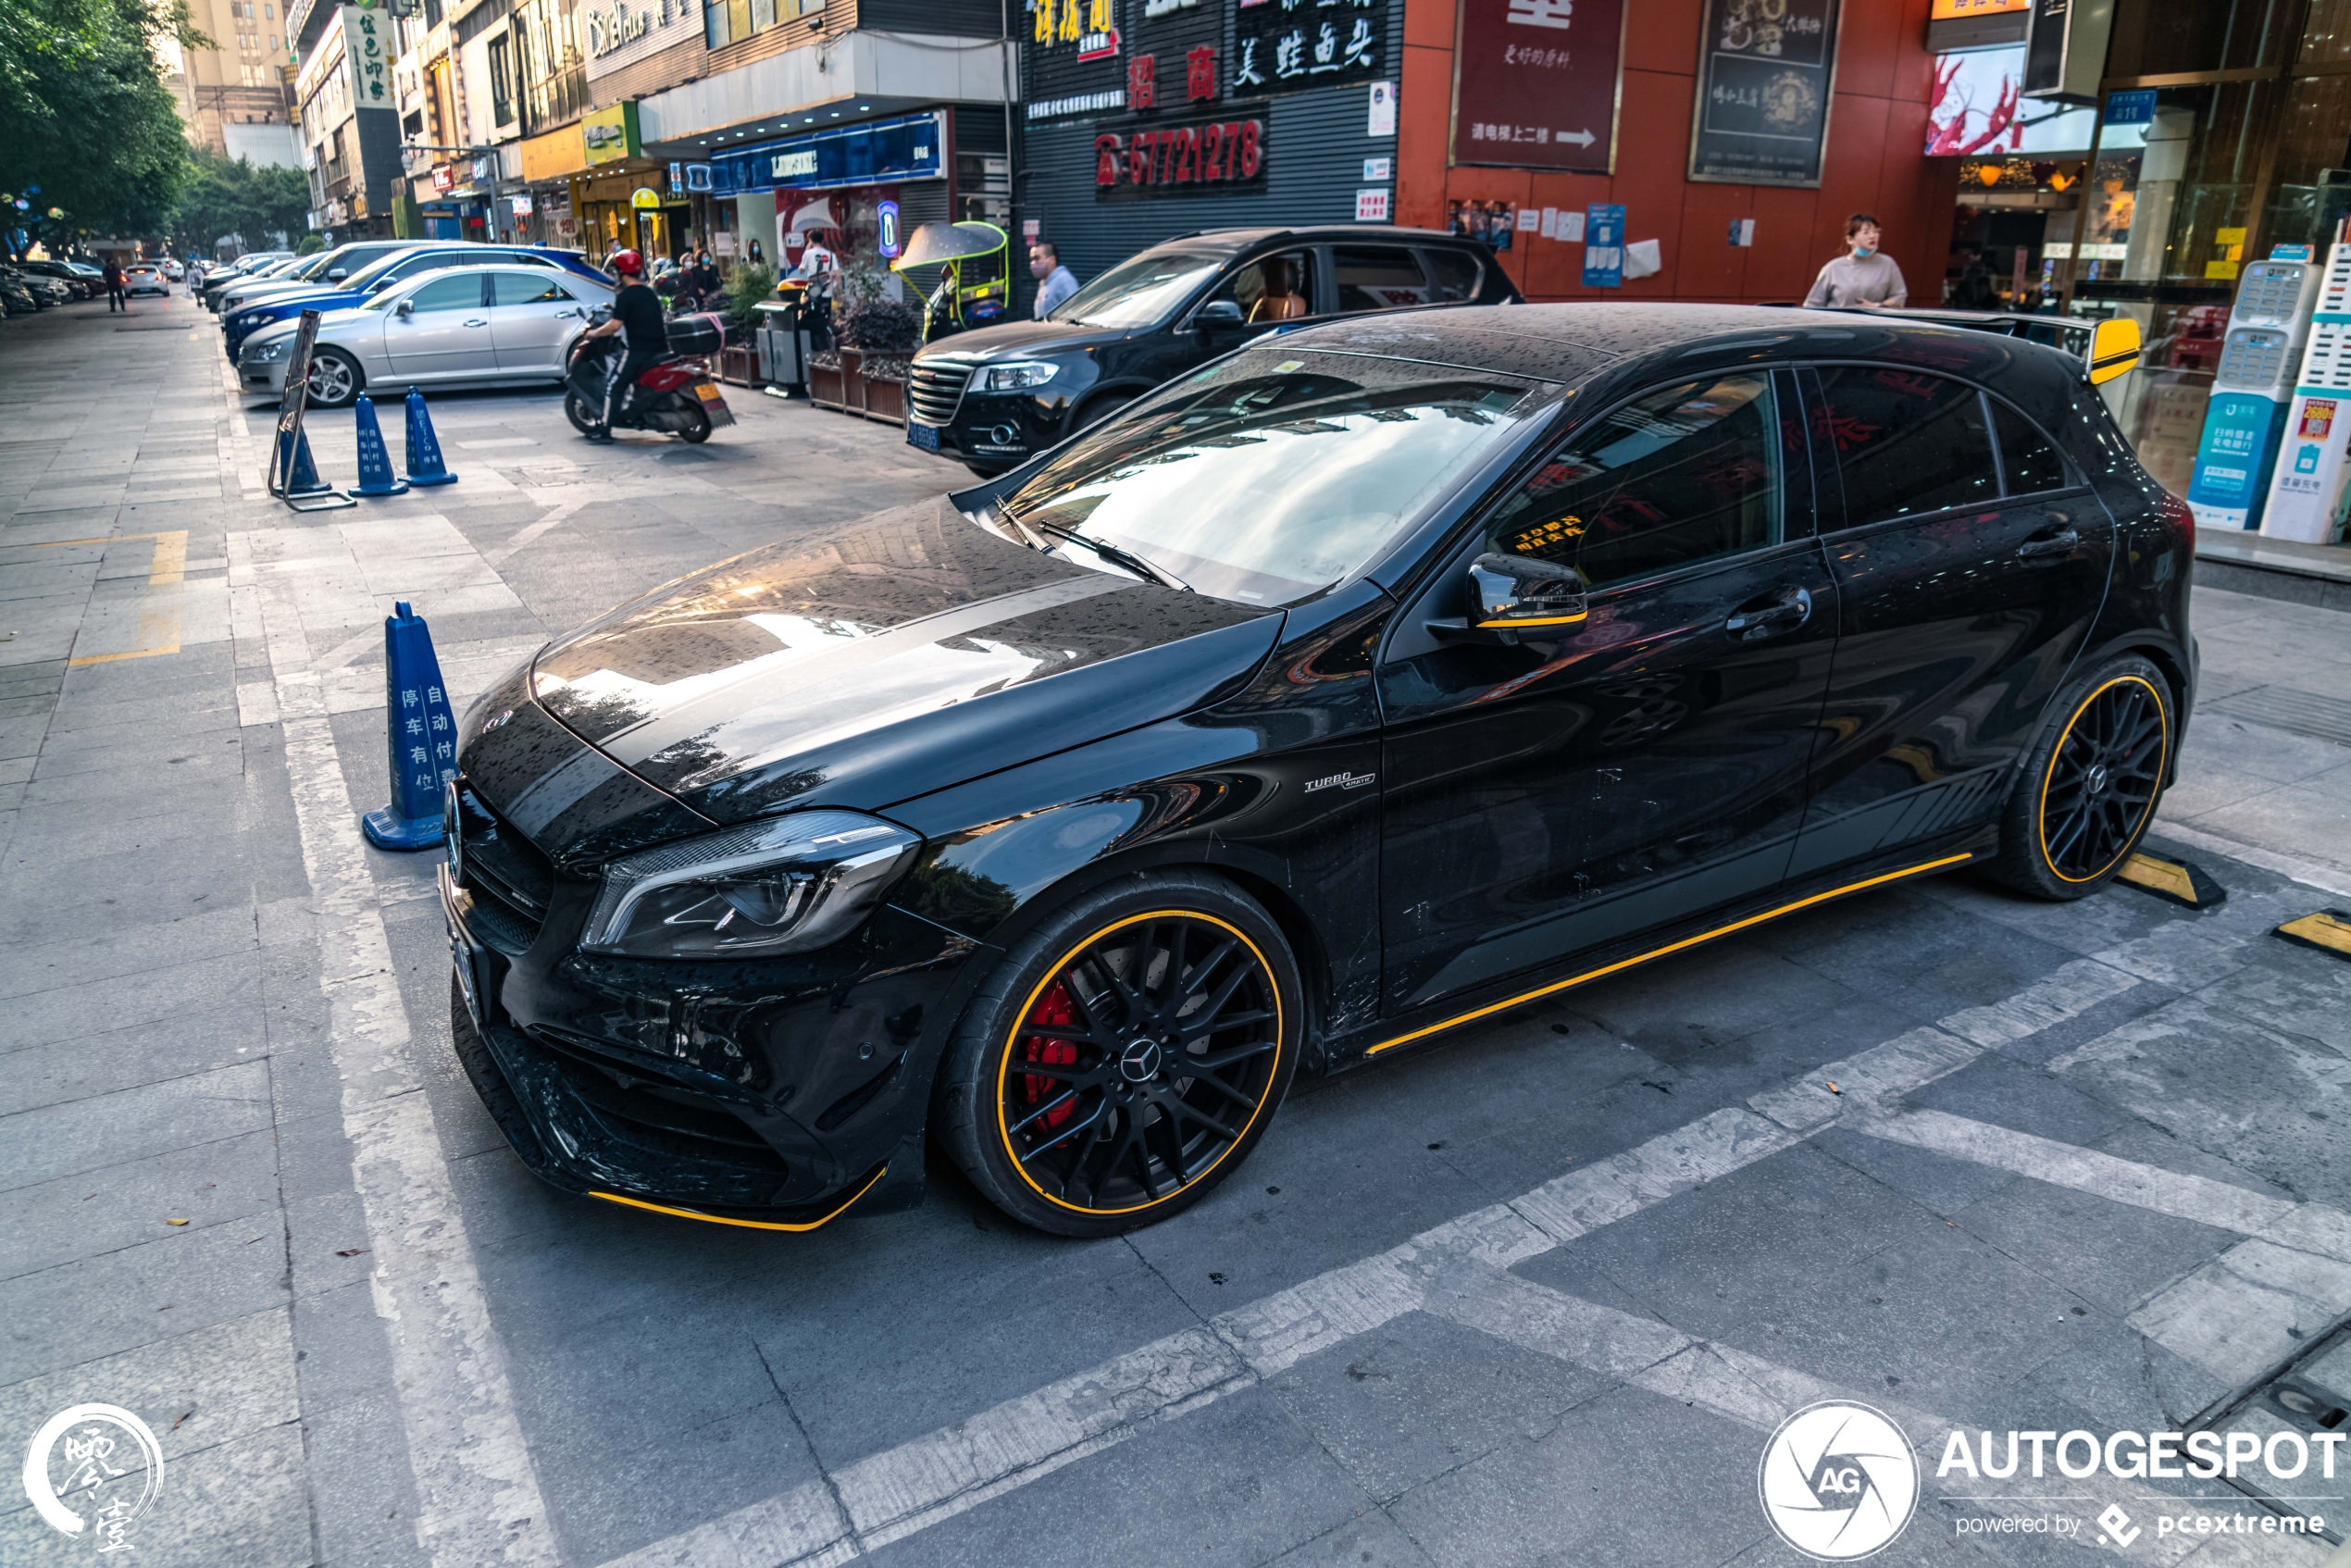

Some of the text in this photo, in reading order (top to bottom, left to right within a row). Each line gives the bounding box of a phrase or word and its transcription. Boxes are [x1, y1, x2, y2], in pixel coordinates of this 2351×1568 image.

[1127, 45, 1216, 110] 招商
[1233, 18, 1374, 86] 美蛙鱼头
[1473, 122, 1549, 144] 请电梯上二楼
[402, 689, 434, 791] 停车有位
[428, 686, 458, 788] 自动付费
[1305, 771, 1351, 790] TURBO
[1345, 777, 1372, 787] 4MATIC
